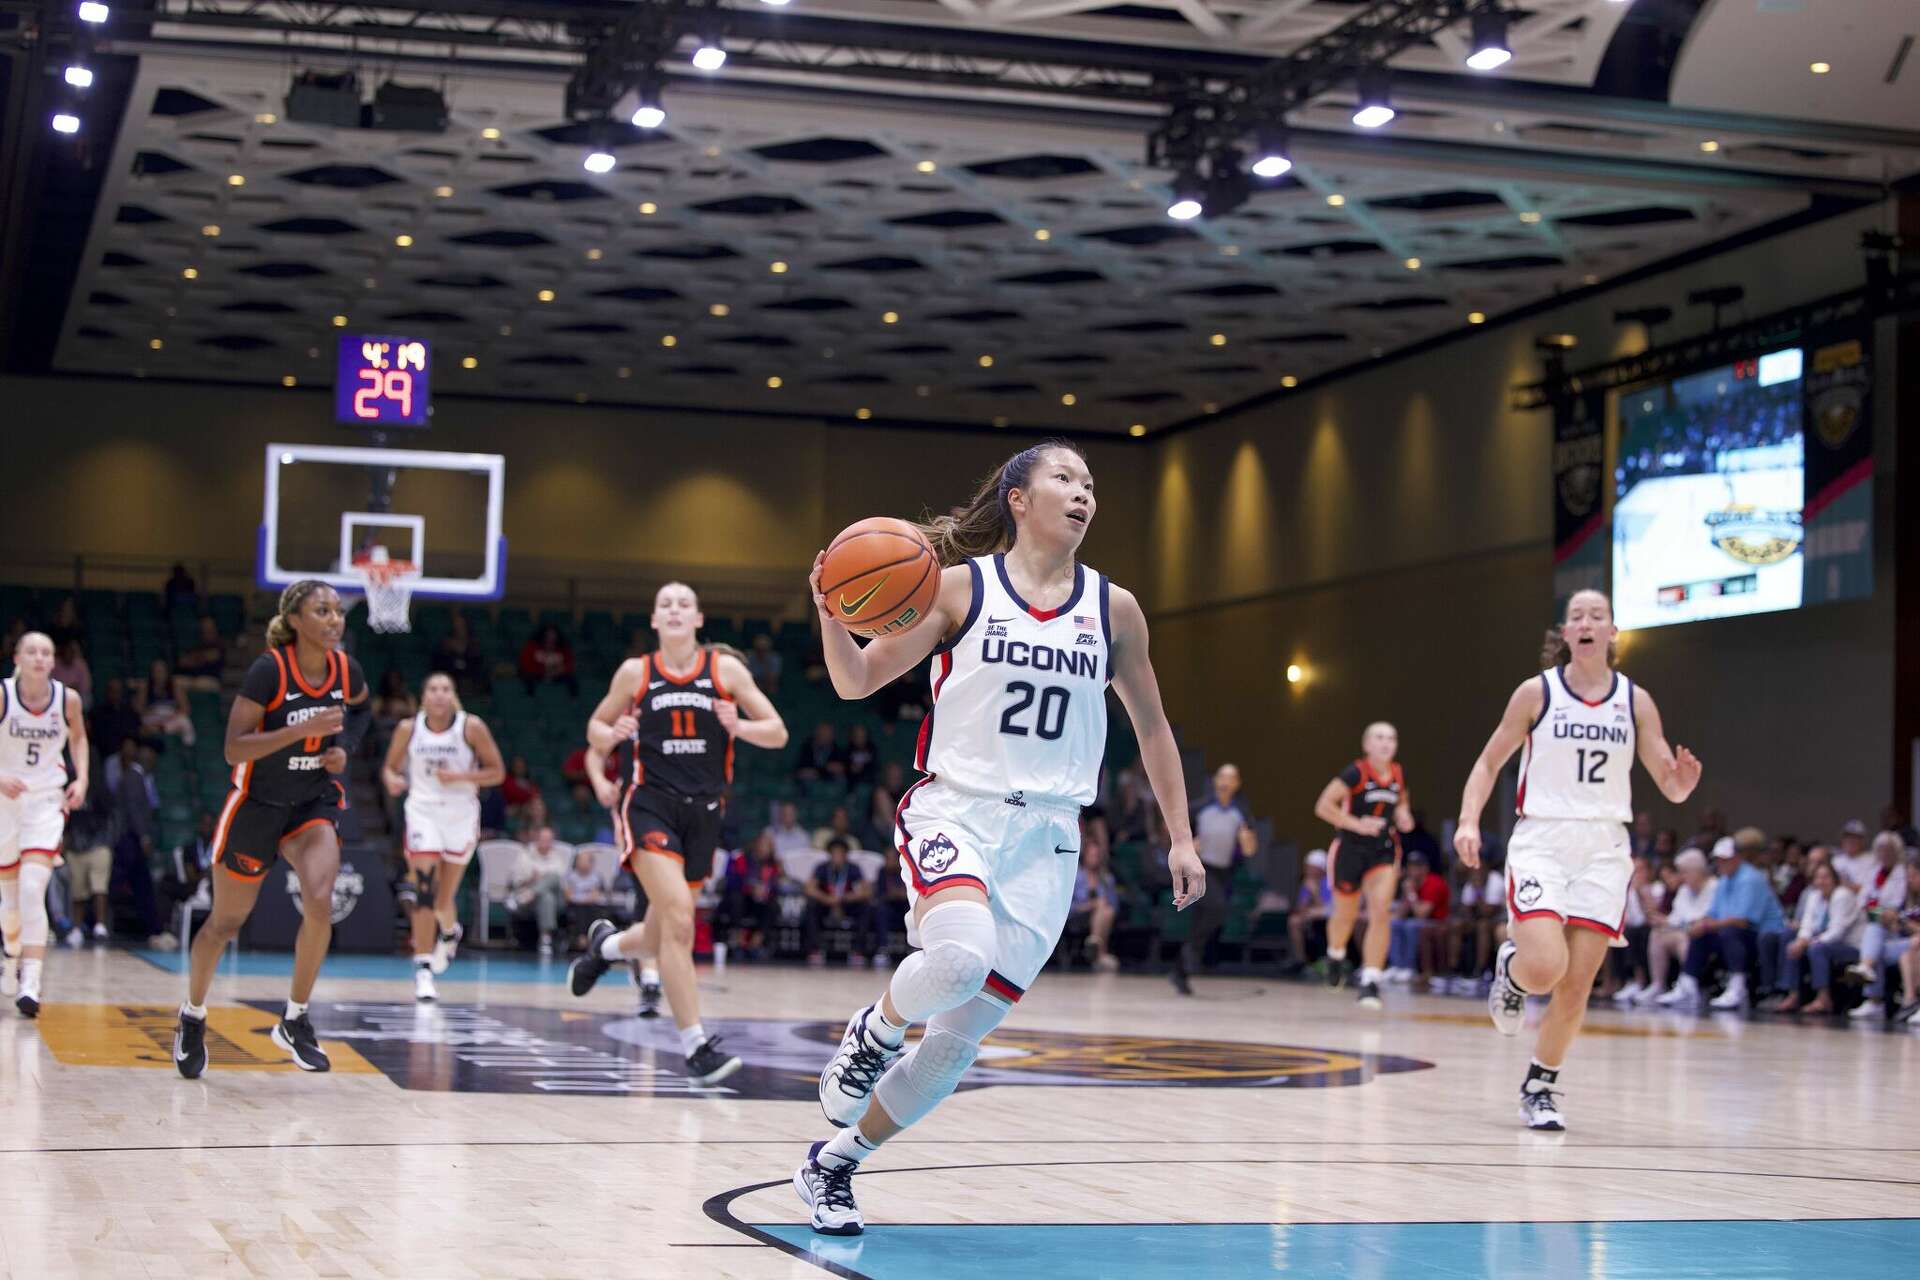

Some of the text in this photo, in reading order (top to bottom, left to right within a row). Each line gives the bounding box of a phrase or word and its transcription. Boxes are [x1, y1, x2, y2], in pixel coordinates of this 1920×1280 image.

[362, 342, 425, 371] 4:19
[354, 369, 412, 418] 29
[984, 630, 1008, 638] CHANGE
[981, 638, 1099, 680] UCONN
[651, 692, 712, 711] OREGON
[999, 680, 1071, 741] 20
[9, 717, 60, 739] UCONN
[671, 710, 697, 737] 11
[1554, 723, 1628, 745] UCONN
[26, 742, 42, 766] 5
[662, 739, 707, 755] STATE
[1576, 748, 1609, 784] 12
[1004, 797, 1027, 808] UCONN
